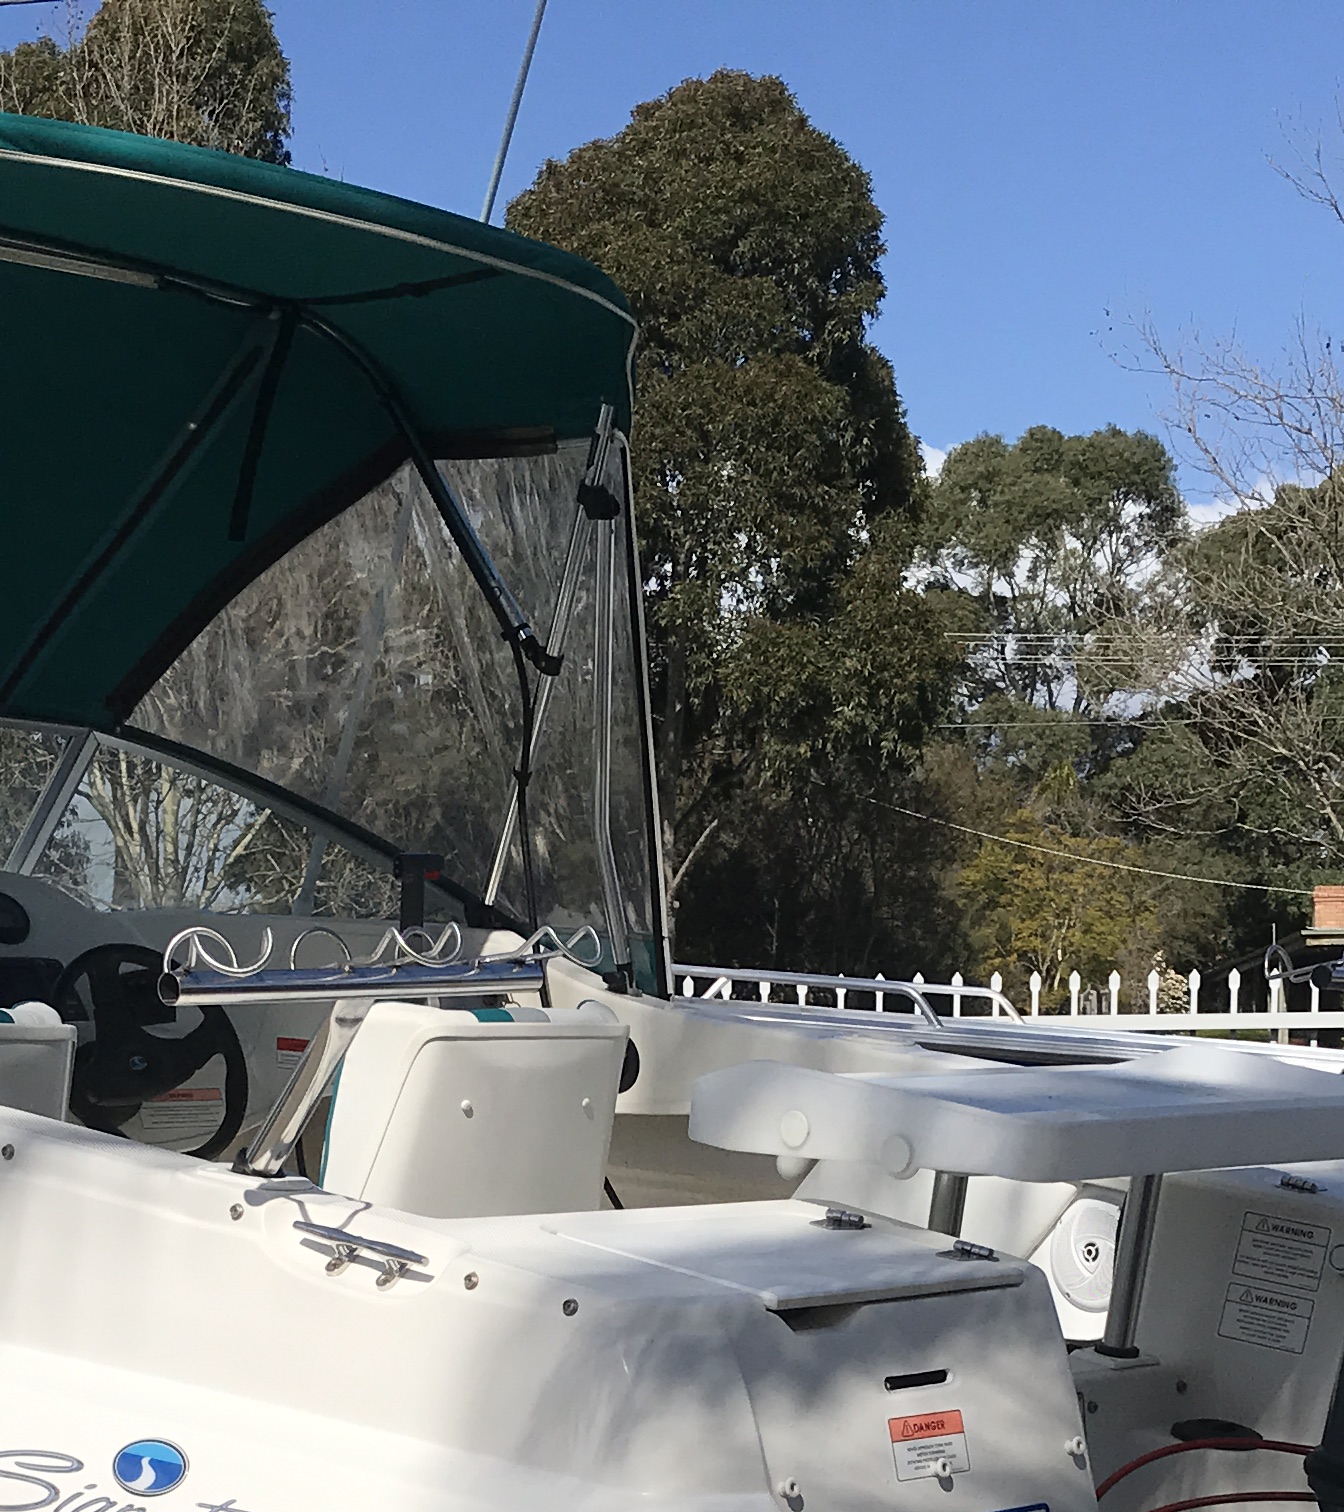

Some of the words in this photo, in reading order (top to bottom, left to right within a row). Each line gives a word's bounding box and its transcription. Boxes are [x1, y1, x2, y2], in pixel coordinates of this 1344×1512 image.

[1271, 1223, 1314, 1239] WARNING
[1255, 1294, 1297, 1310] WARNING
[913, 1419, 946, 1434] DANGER
